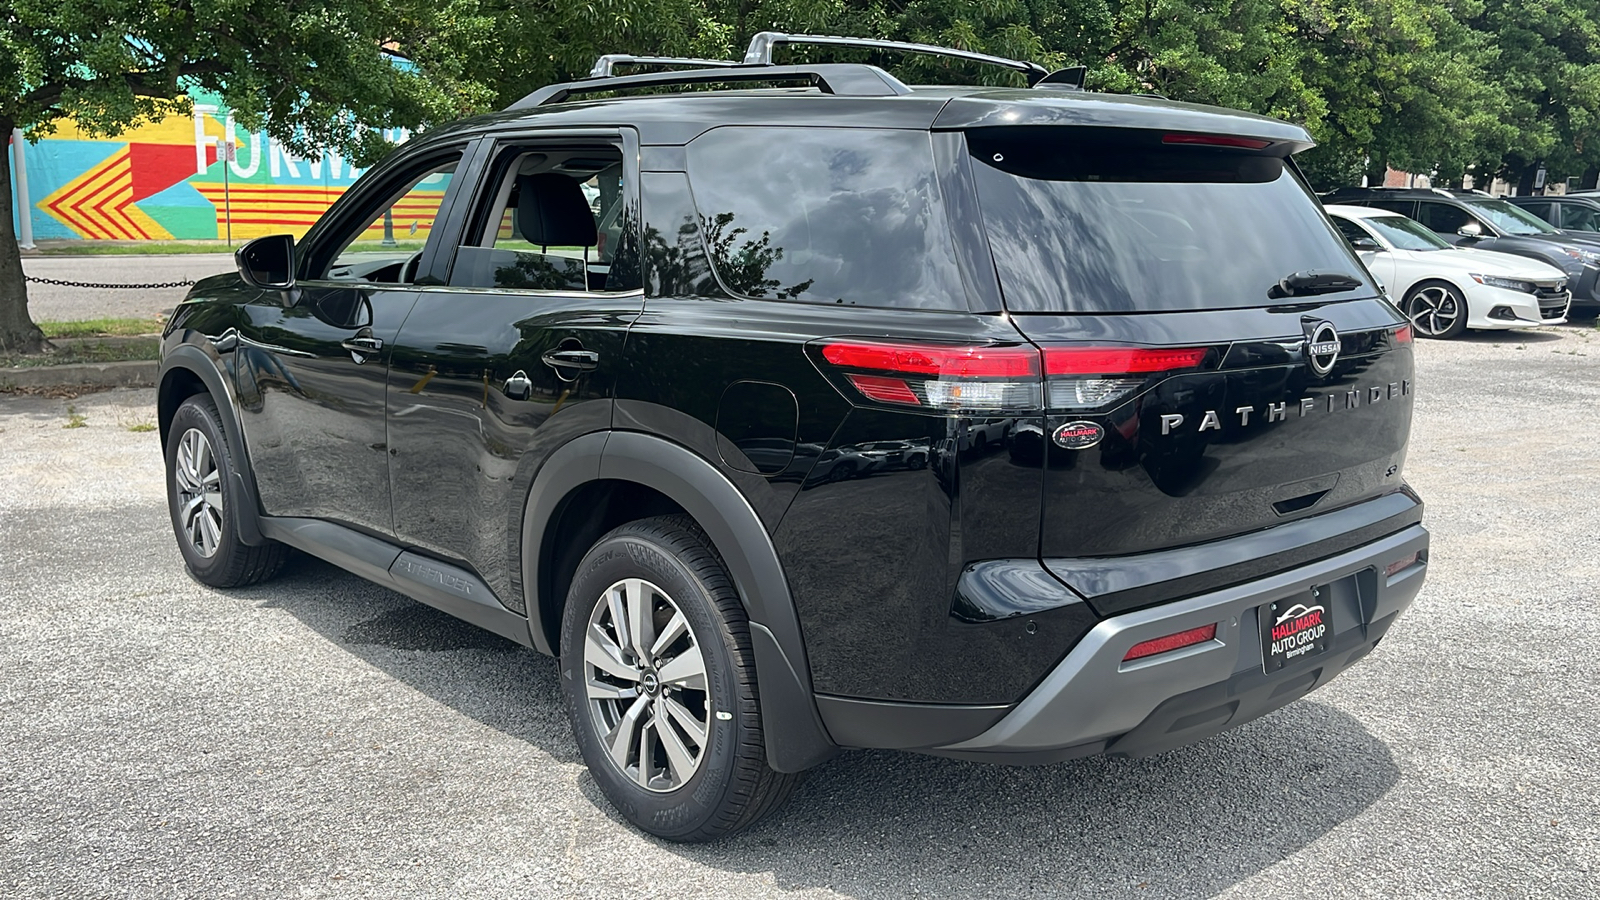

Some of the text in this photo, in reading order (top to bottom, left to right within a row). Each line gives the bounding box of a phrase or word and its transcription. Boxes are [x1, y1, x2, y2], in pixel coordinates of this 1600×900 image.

[1310, 343, 1341, 354] NISSAN
[1160, 379, 1411, 435] PATHFINDER
[1060, 428, 1097, 437] HALLMARK
[396, 557, 473, 594] PATHFINDER
[1271, 611, 1322, 641] HALLMARK
[1271, 624, 1326, 656] AUTO GROUP
[1286, 642, 1315, 659] Birmingham
